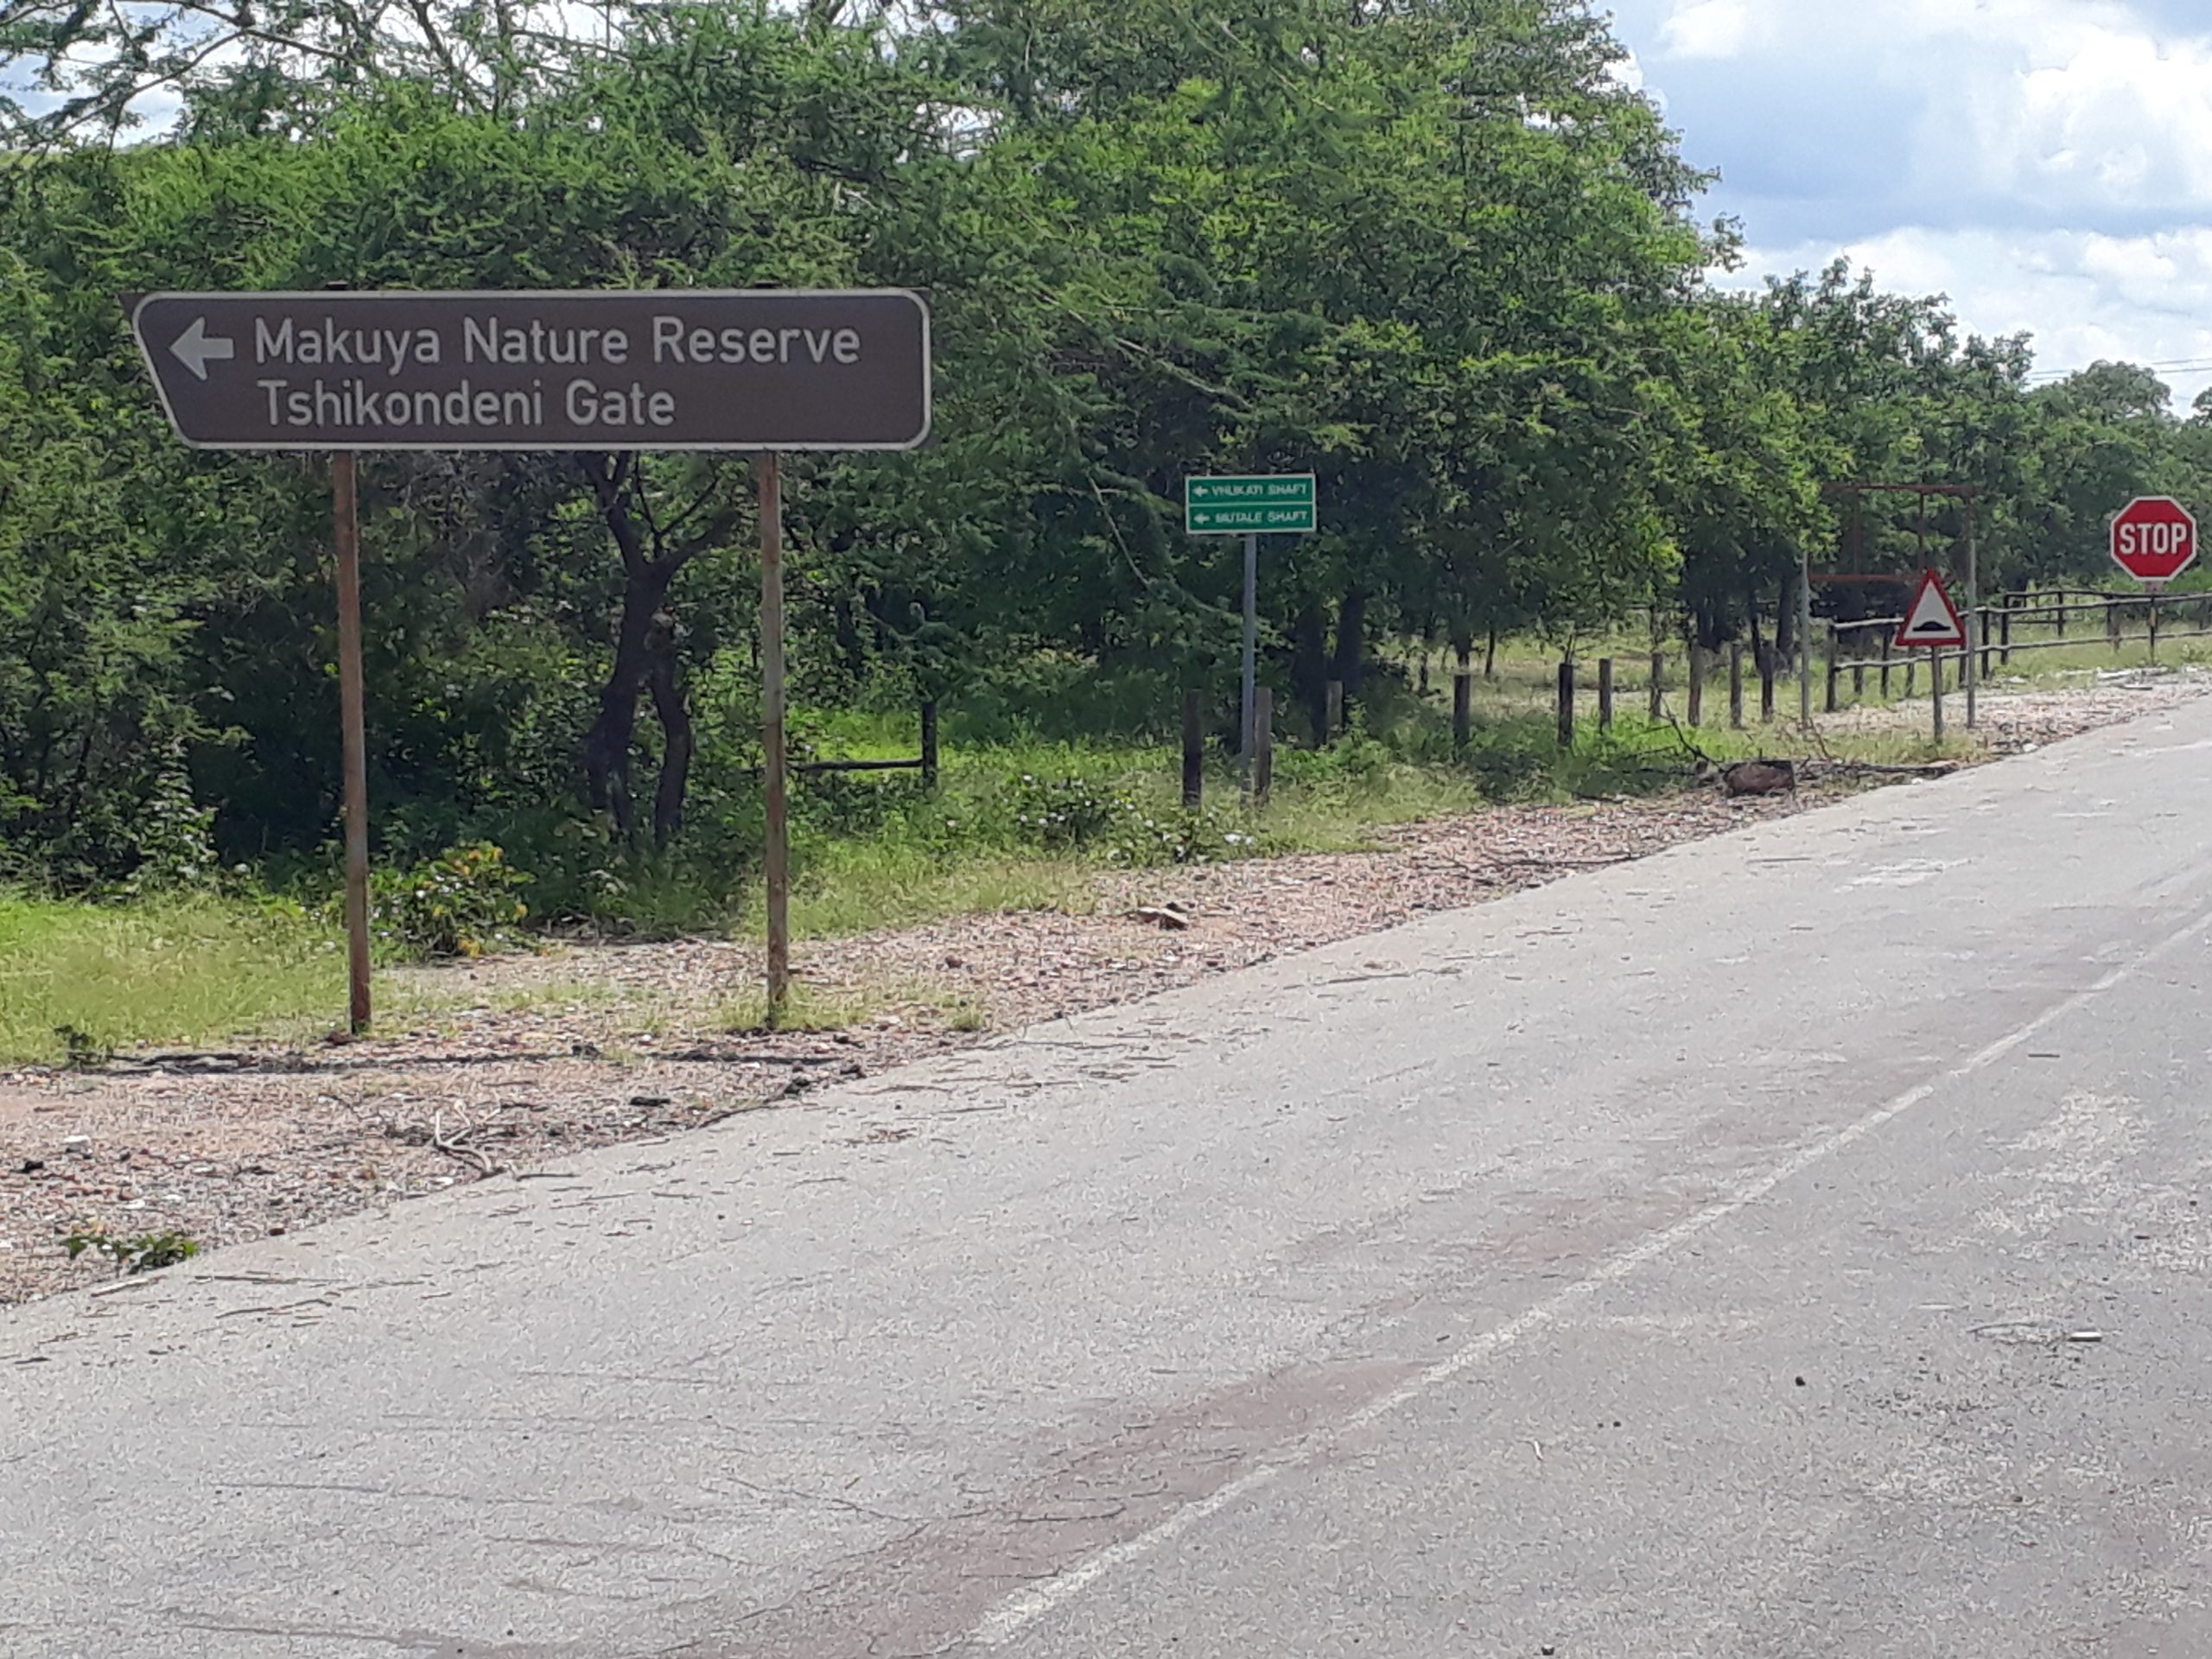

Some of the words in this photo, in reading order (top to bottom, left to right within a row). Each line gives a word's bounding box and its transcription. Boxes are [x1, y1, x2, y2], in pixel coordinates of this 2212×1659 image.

[255, 316, 441, 376] Makuya
[463, 316, 629, 364] Nature
[652, 315, 861, 364] Reserve
[257, 379, 543, 426] Tshikondeni
[565, 378, 676, 426] Gate
[1268, 483, 1307, 495] SHAFT
[1267, 511, 1307, 523] SHAFT
[2119, 522, 2188, 556] STOP
